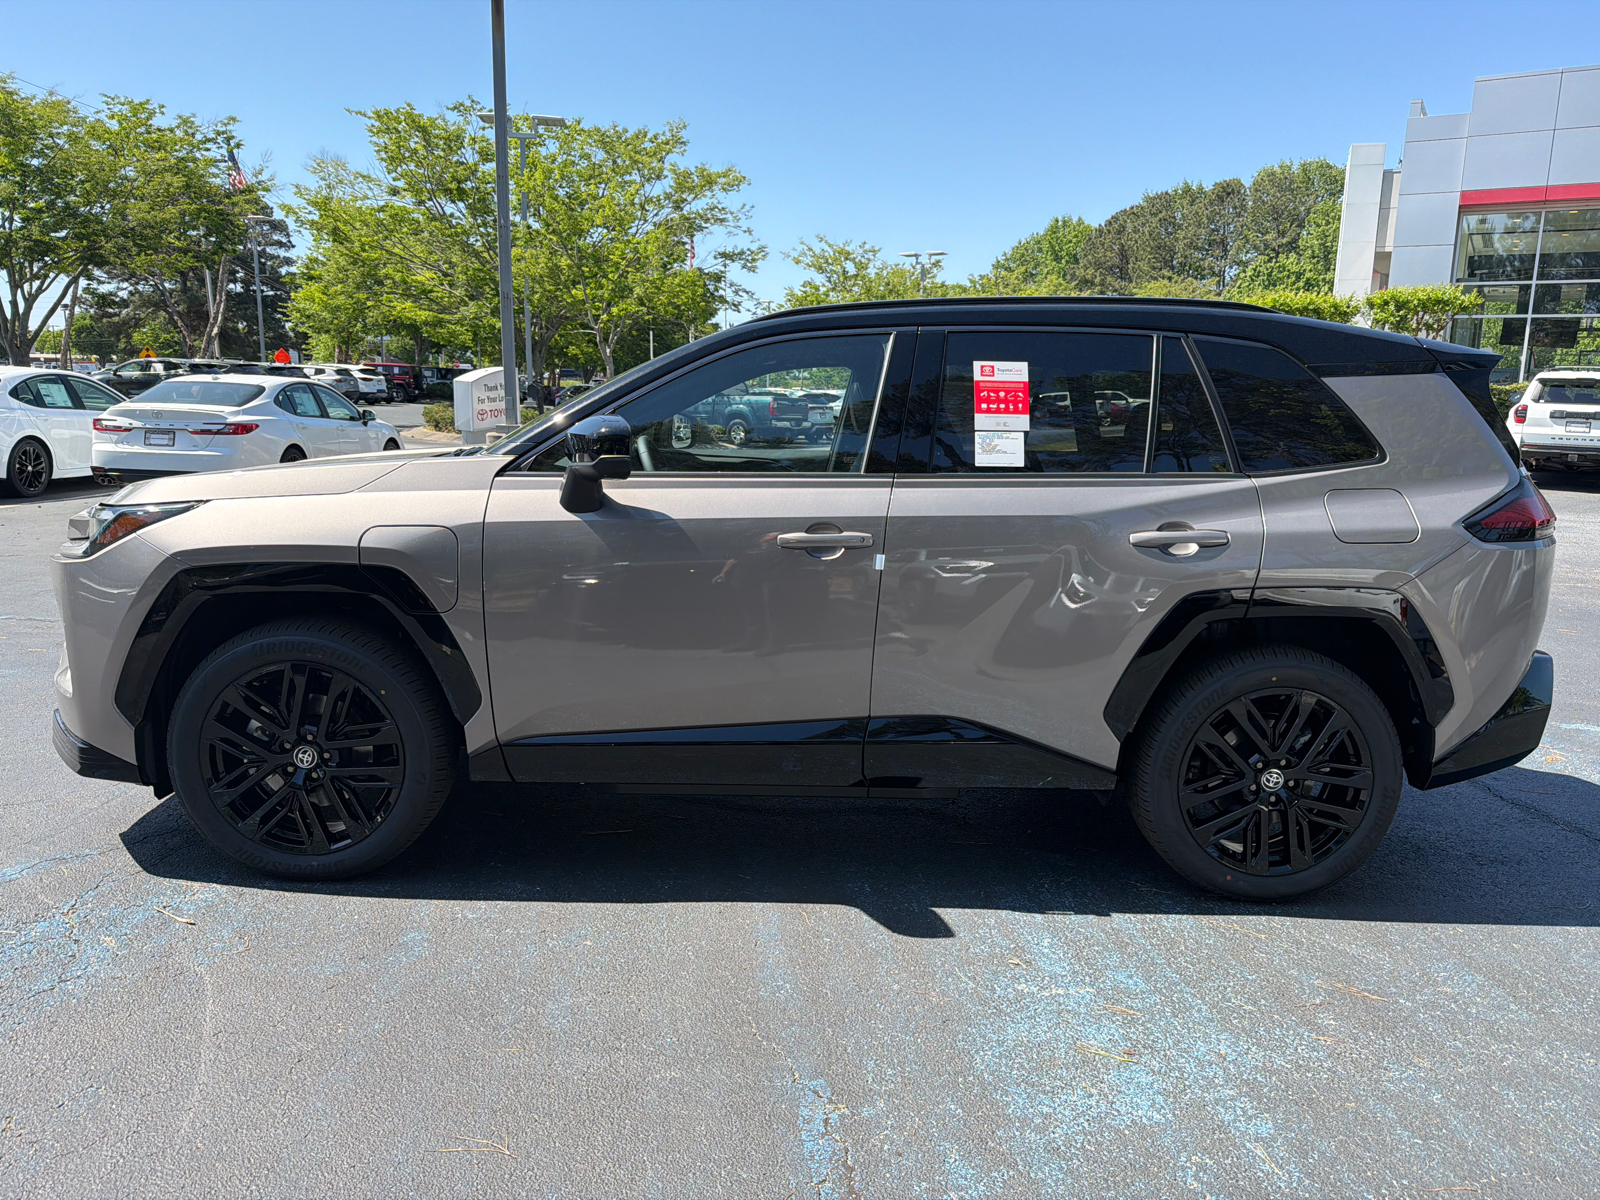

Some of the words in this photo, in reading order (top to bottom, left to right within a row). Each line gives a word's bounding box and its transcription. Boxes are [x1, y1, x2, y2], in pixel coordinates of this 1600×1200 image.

[483, 383, 498, 392] Thank
[478, 396, 486, 404] For
[251, 640, 370, 674] BRIDGESTONE
